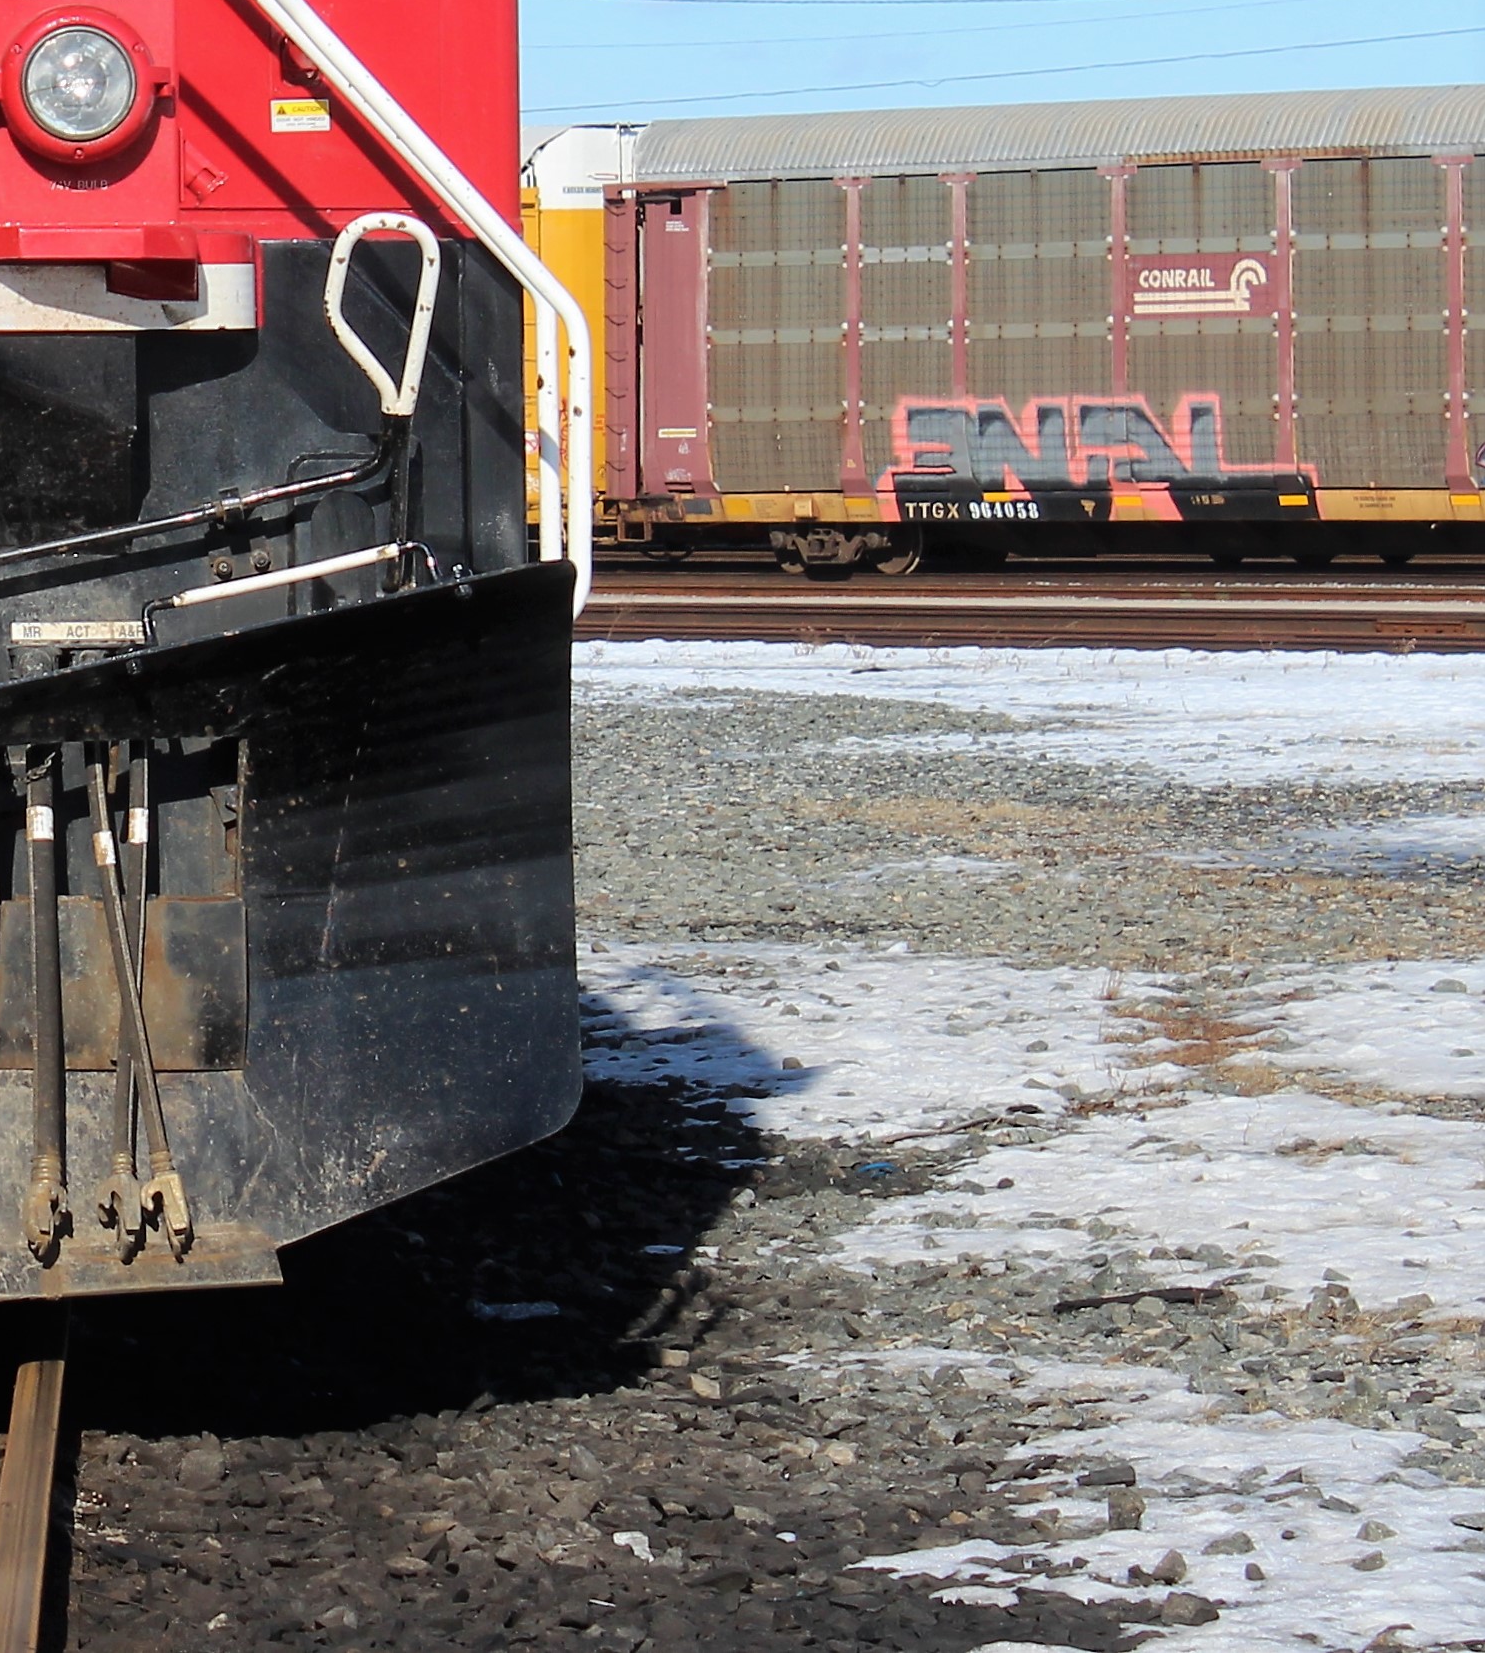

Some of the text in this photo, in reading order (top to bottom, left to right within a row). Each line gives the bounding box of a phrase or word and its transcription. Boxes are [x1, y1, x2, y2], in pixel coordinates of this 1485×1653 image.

[1138, 268, 1215, 288] CONRAIL
[904, 501, 1040, 520] TTGX 964058
[66, 625, 91, 638] ACT
